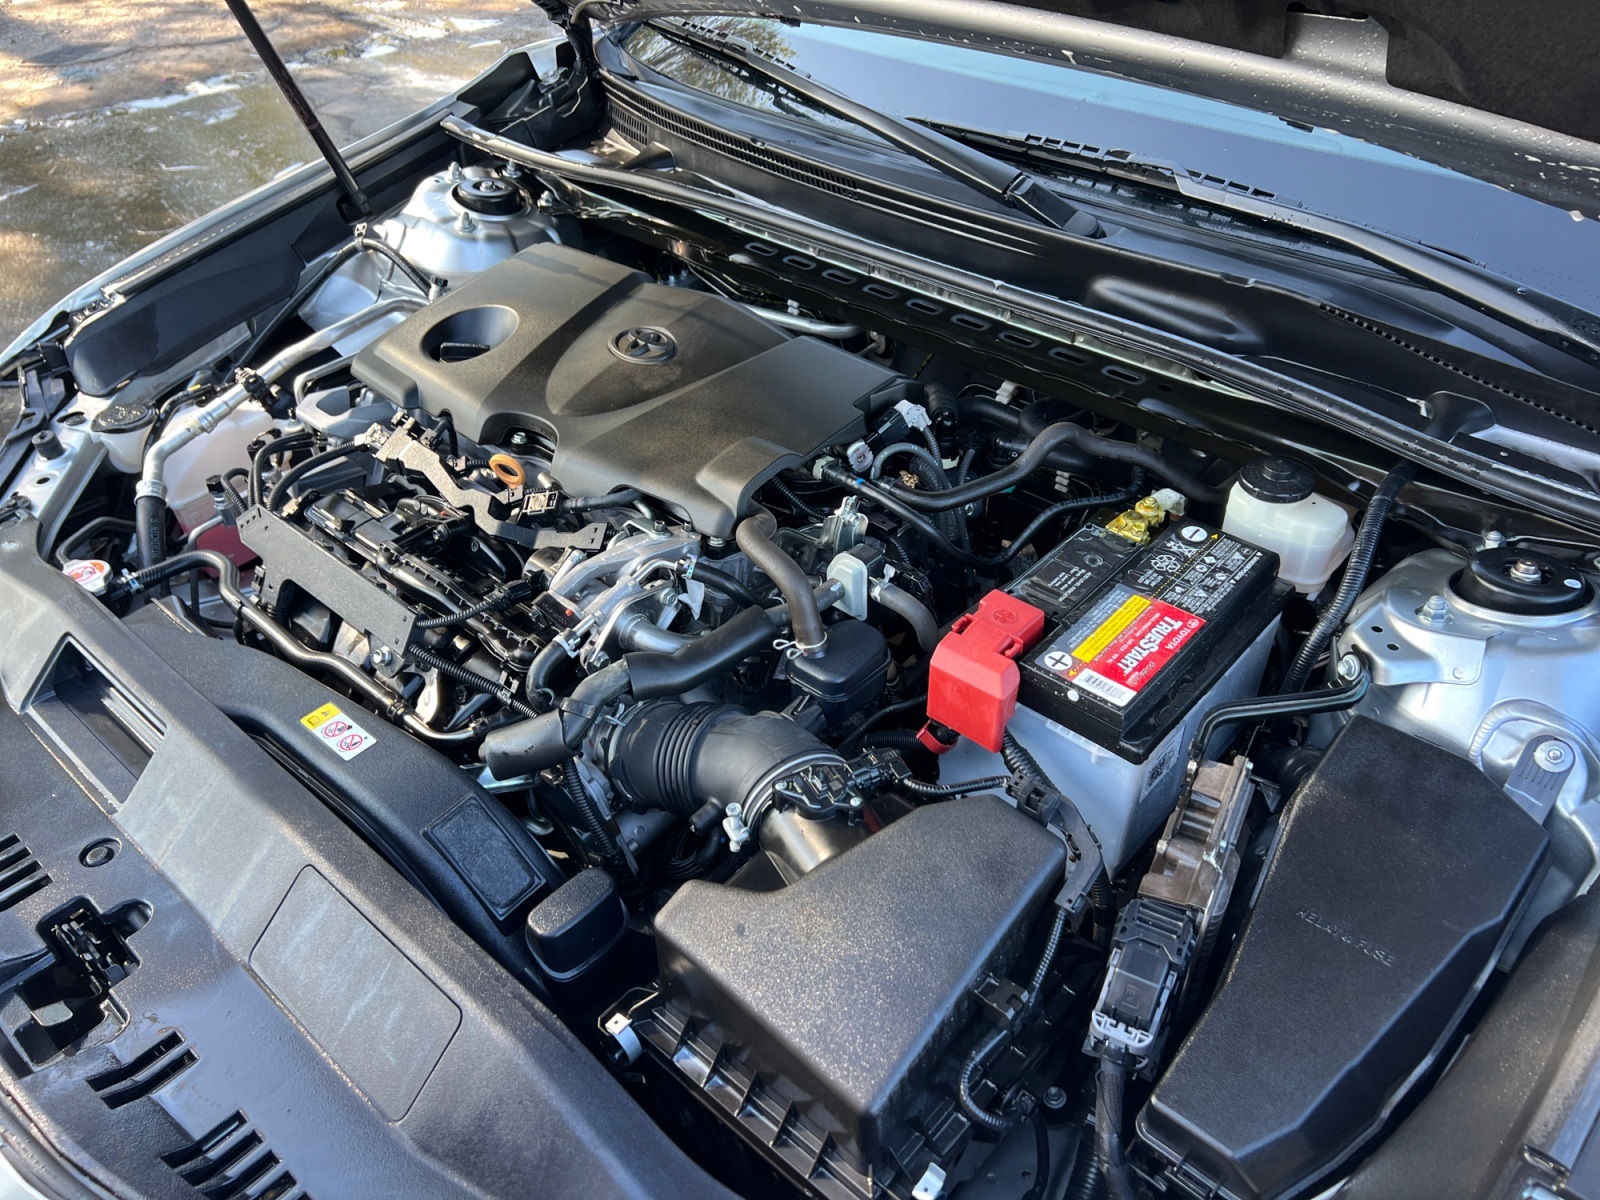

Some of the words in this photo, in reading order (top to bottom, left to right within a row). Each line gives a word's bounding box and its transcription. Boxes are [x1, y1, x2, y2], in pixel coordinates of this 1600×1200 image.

[1115, 615, 1183, 675] TRUESTART
[1164, 626, 1191, 650] TOYOTA
[1355, 939, 1397, 968] FUSE
